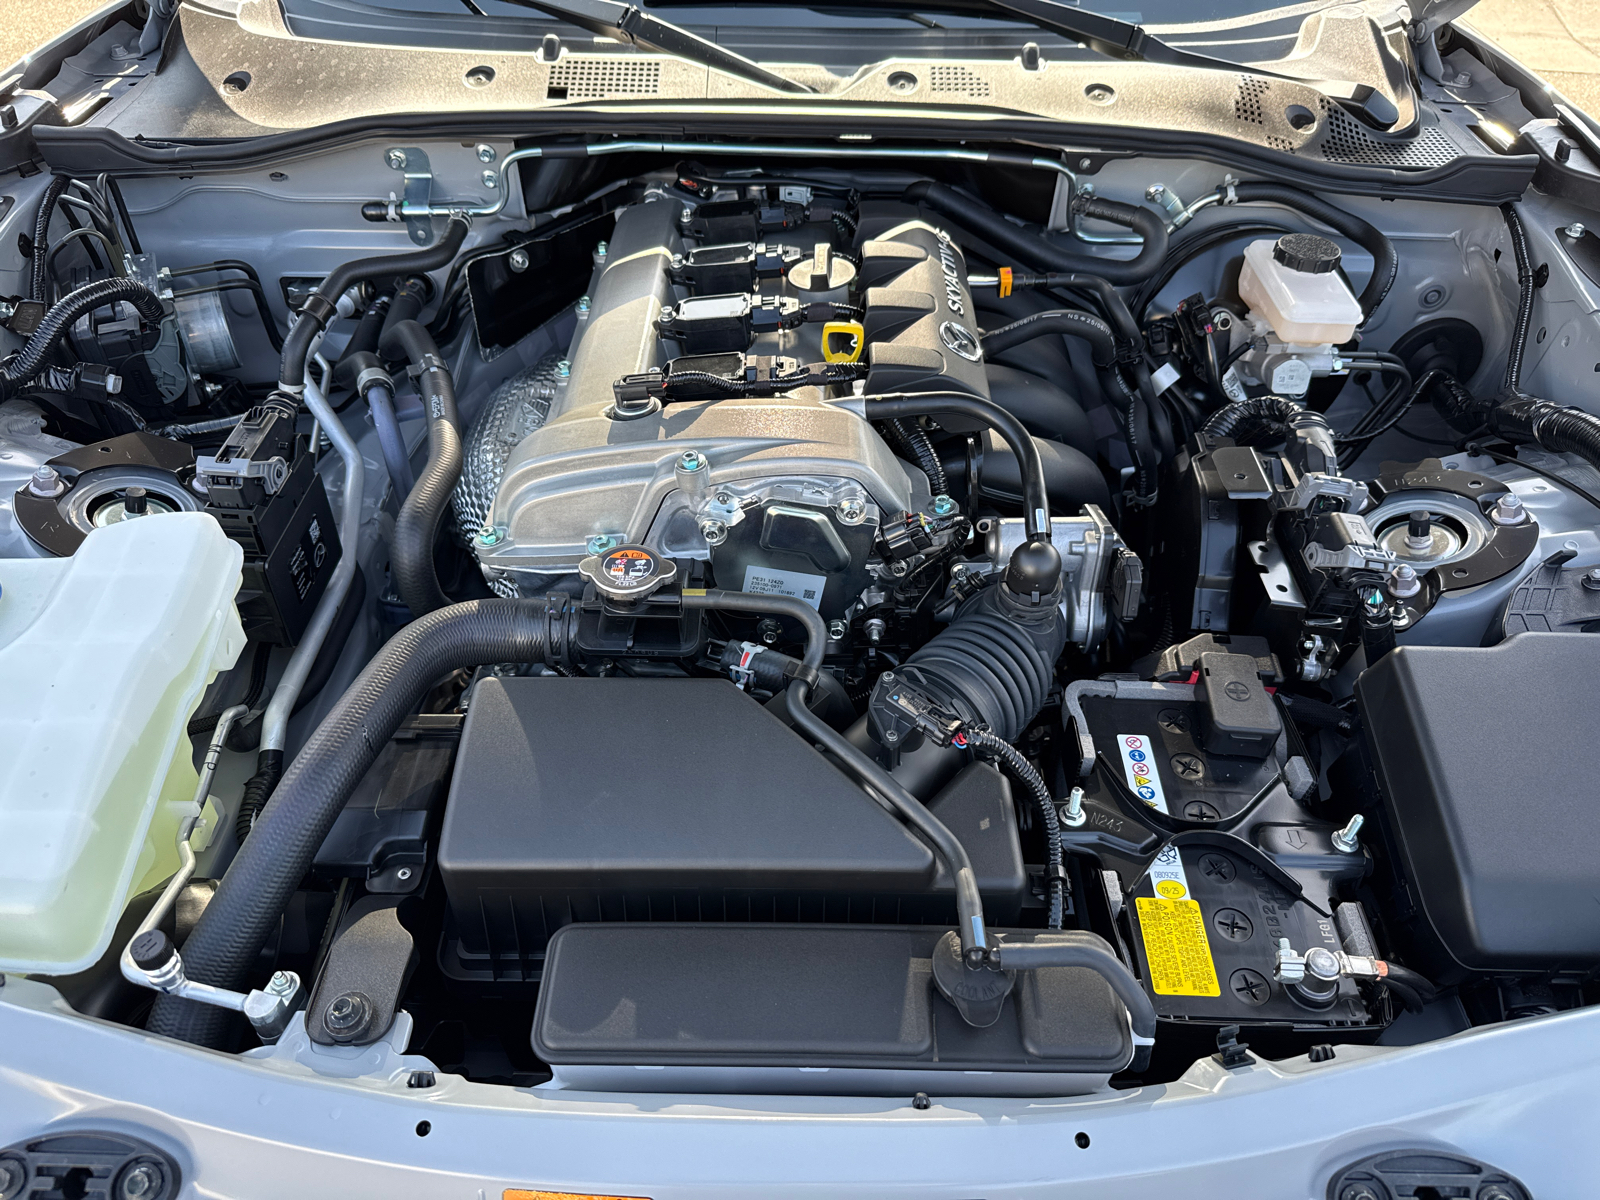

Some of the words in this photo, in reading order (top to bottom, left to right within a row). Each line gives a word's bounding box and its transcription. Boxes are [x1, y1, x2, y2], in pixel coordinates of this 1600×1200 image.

[936, 228, 964, 316] SKYACTIV-G
[1161, 886, 1180, 895] 09/25
[1161, 912, 1173, 935] POISON
[1192, 915, 1206, 943] DANGER
[1166, 936, 1175, 953] CAUSES
[1170, 954, 1179, 970] SEVERE
[1198, 944, 1210, 968] EXPLOSIVE
[1154, 959, 1164, 980] CHILDREN
[1174, 972, 1183, 987] BURNS
